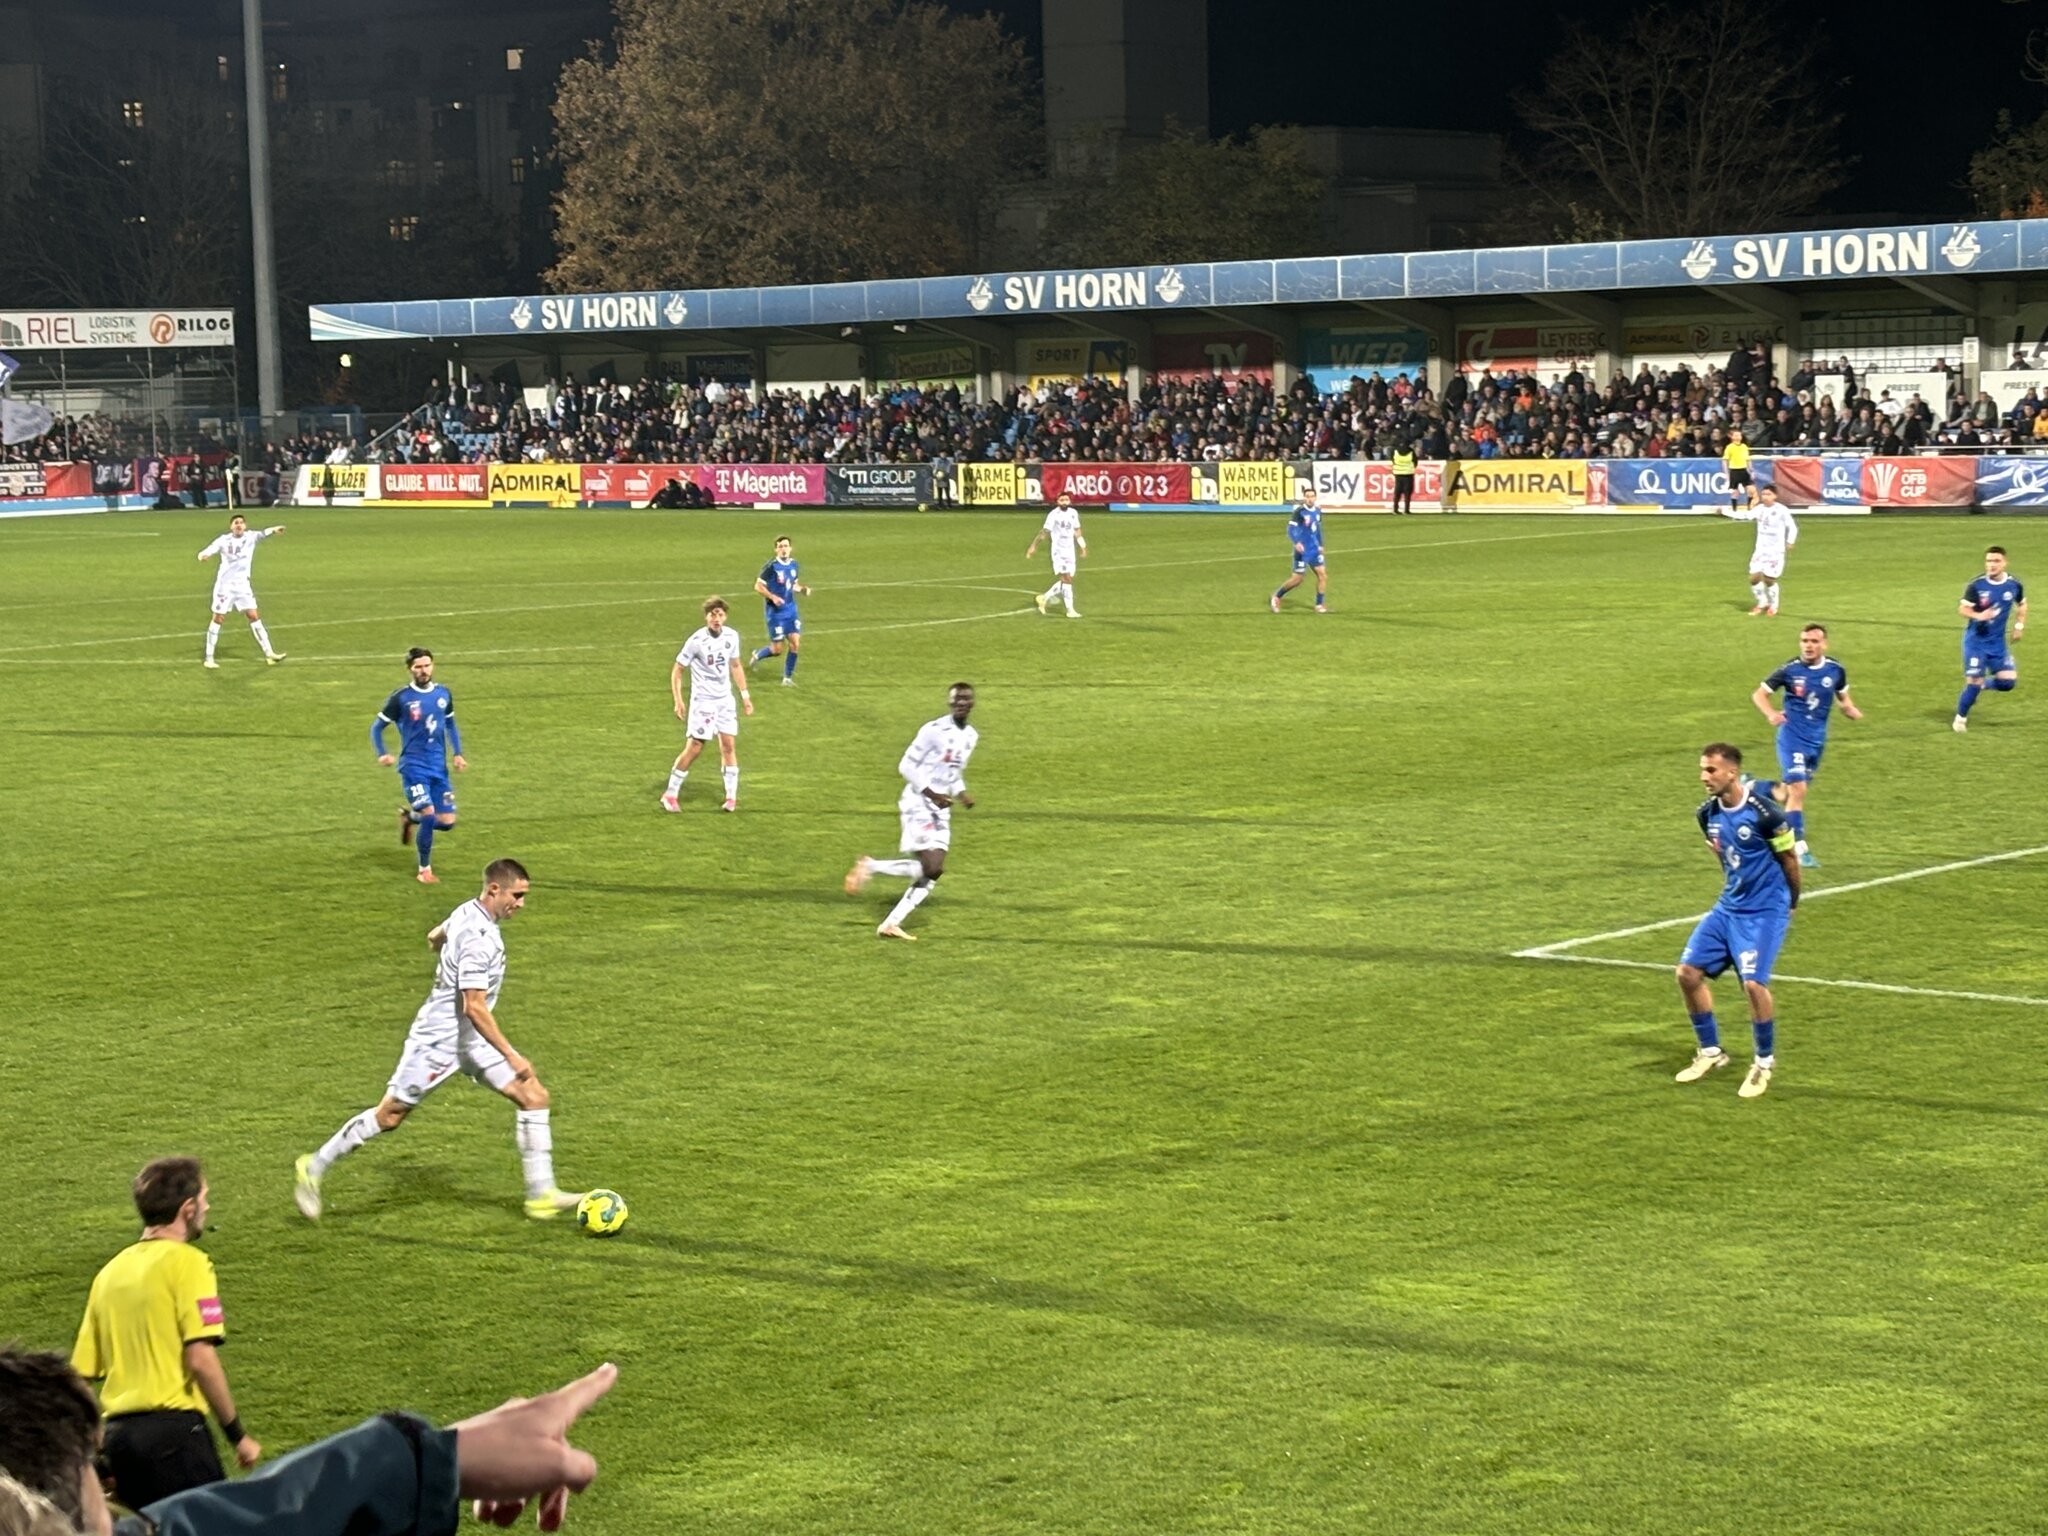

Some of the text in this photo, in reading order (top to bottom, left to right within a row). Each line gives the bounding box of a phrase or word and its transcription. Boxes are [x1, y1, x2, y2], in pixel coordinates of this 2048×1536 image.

[1732, 230, 1928, 280] SV HORN
[1004, 271, 1147, 311] SV HORN
[541, 296, 657, 330] SV HORN
[27, 317, 88, 344] RIEL
[89, 317, 136, 328] LOGISTIK
[178, 318, 231, 332] RILOG
[90, 332, 137, 344] SYSTEME
[1541, 332, 1596, 347] LEYRER
[1036, 348, 1081, 363] SPORT
[1204, 342, 1248, 376] TV
[1886, 383, 1921, 391] PRESSE
[2003, 382, 2040, 390] PRESSE
[870, 470, 917, 484] GROUP
[1223, 465, 1278, 482] WÄRME
[386, 473, 484, 493] GLAUBE. WILLE. MUT.
[491, 473, 580, 494] ADMIRAL
[733, 470, 807, 498] Magenta
[1064, 471, 1169, 496] ARBÖ 123
[1319, 467, 1438, 499] sky sprt
[1448, 470, 1585, 496] ADMIRAL
[1671, 472, 1746, 495] UNIQ
[963, 486, 1012, 501] PUMPEN
[1224, 486, 1279, 501] PUMPEN
[1822, 487, 1860, 499] UNIQA
[1900, 486, 1927, 498] CUP
